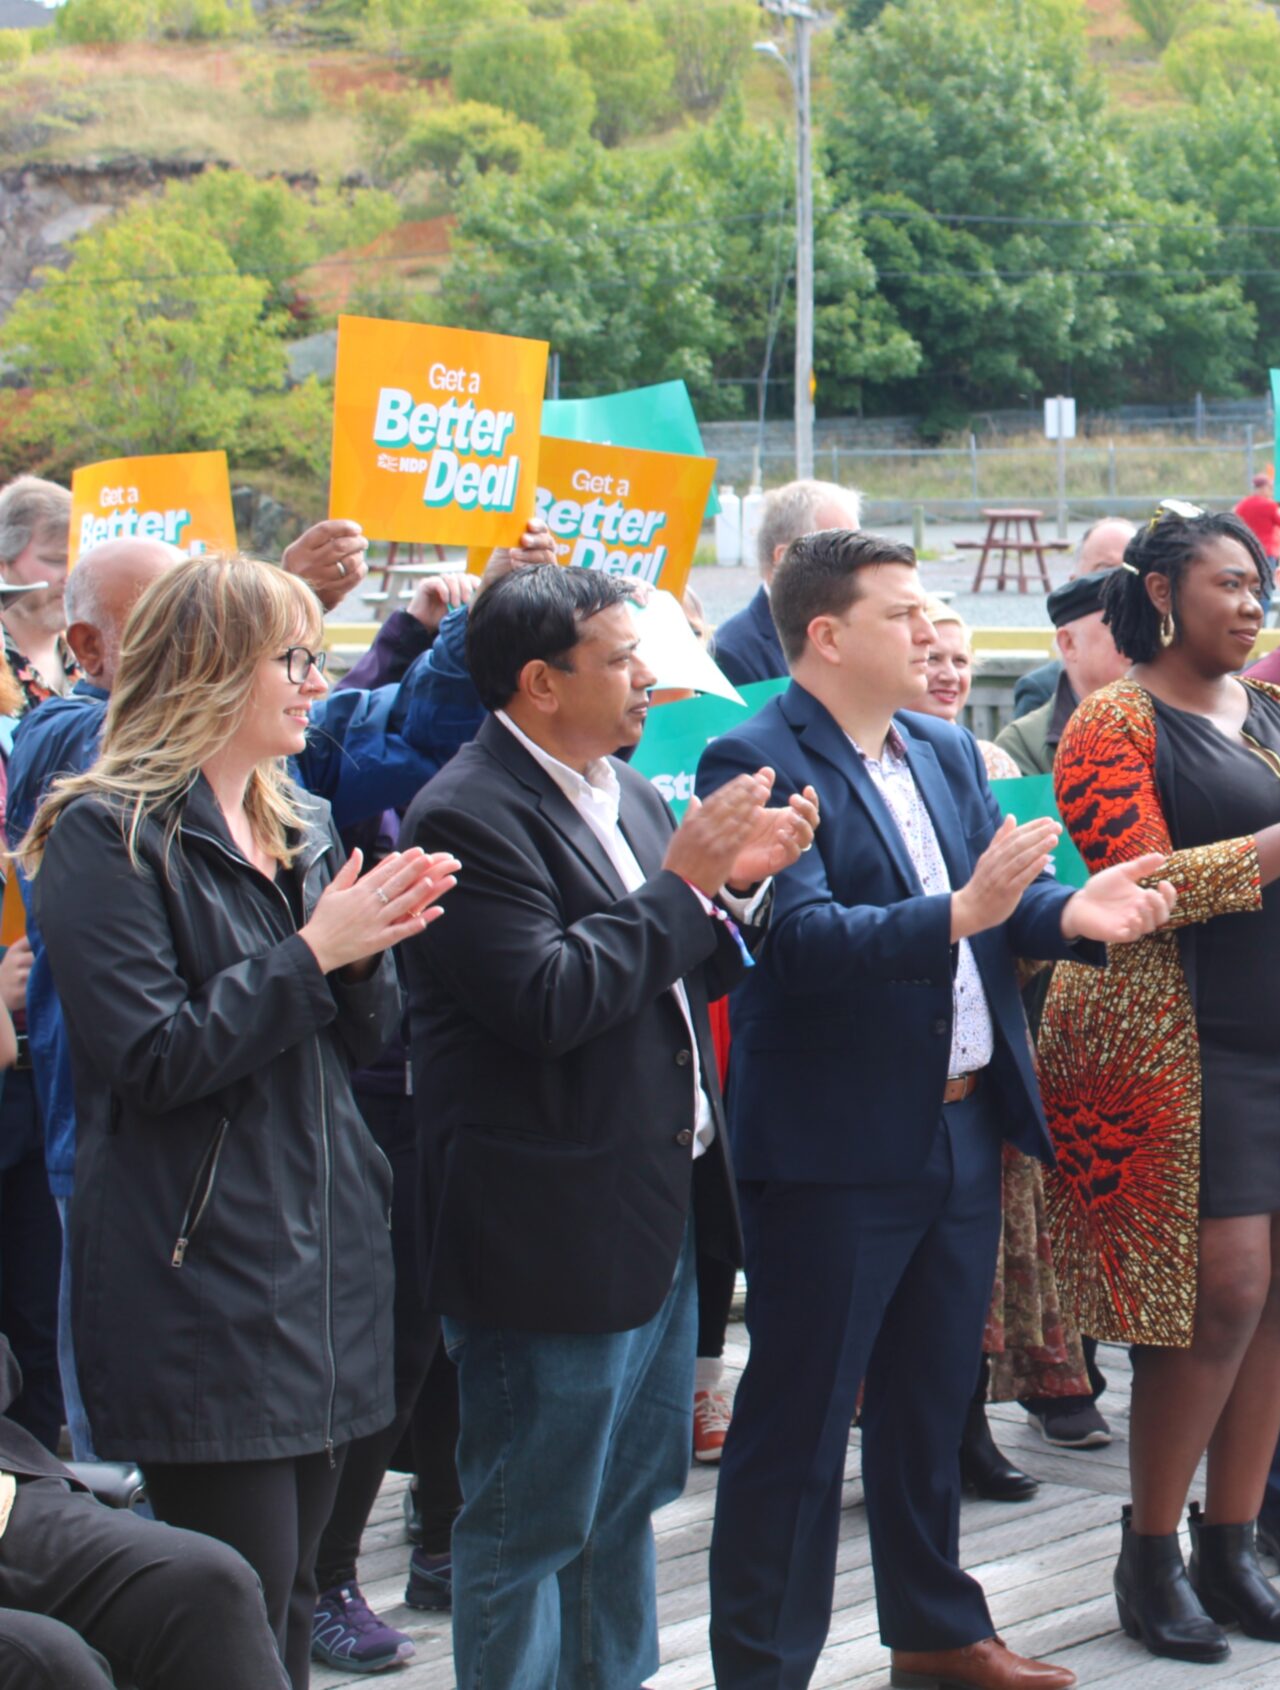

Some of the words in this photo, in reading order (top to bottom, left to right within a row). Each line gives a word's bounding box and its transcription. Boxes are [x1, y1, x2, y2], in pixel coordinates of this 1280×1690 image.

[429, 363, 466, 393] Get
[468, 372, 481, 394] a
[373, 387, 515, 457] Better
[399, 457, 428, 474] NDP
[423, 449, 520, 512] Deal
[100, 486, 124, 508] Get
[127, 486, 139, 504] a
[571, 469, 613, 495] Get
[616, 479, 630, 496] a
[80, 508, 191, 548] Better
